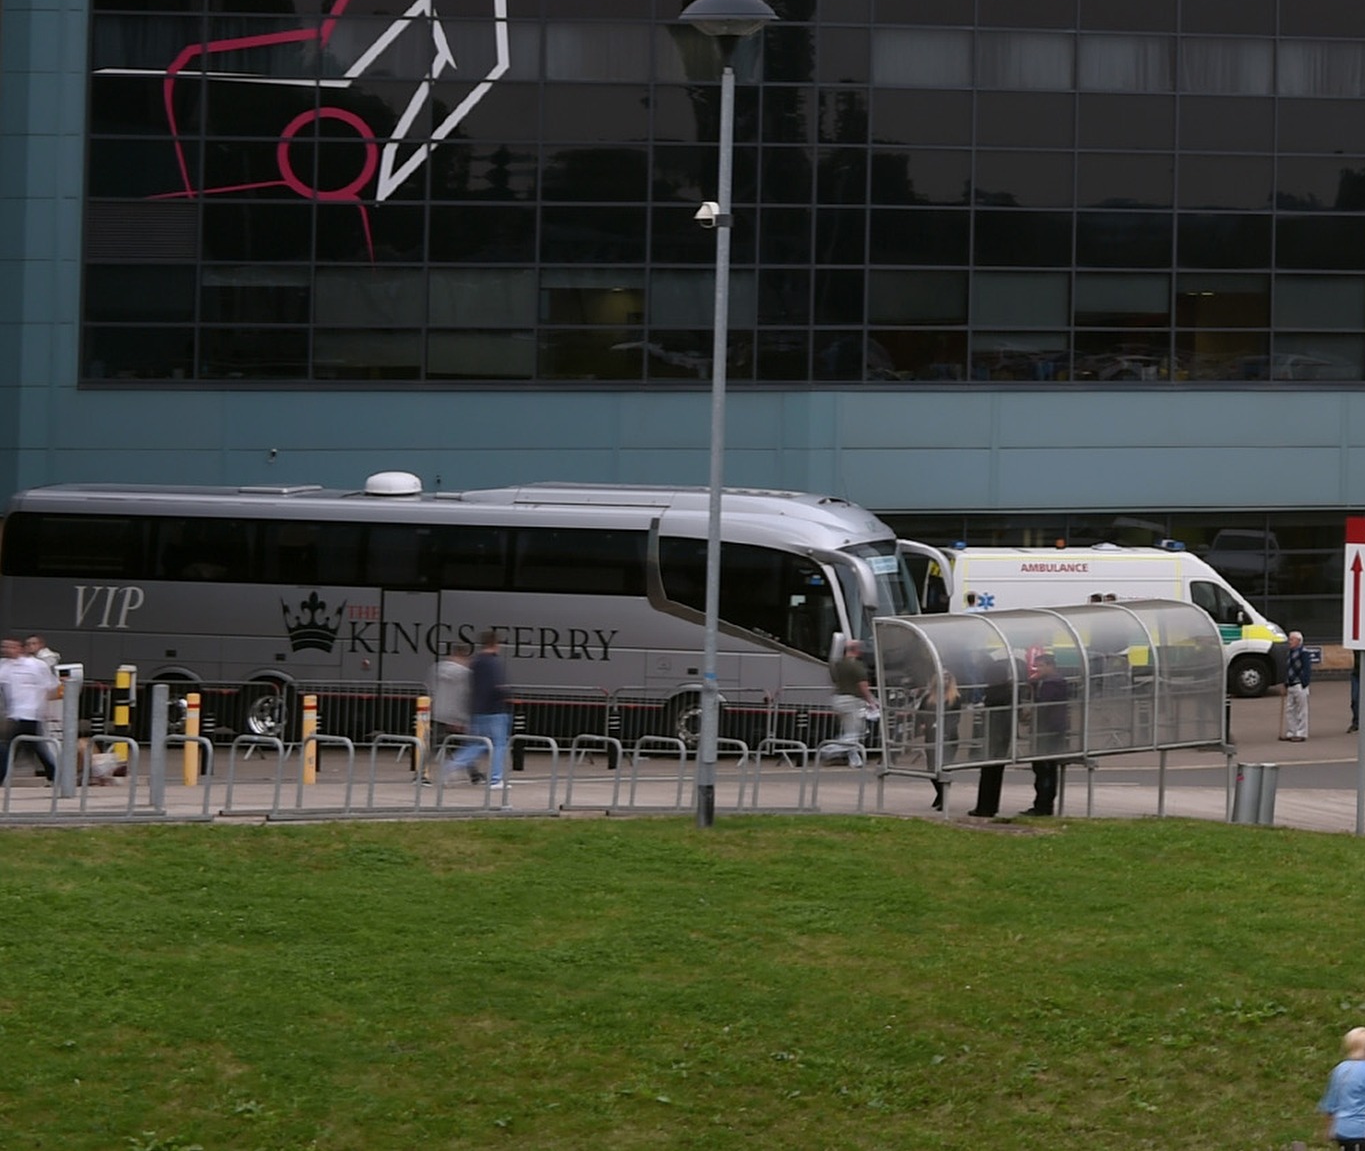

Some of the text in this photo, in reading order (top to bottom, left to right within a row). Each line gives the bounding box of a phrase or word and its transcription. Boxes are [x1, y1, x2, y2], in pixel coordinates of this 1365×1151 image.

[1020, 562, 1089, 573] AMBULANCE
[74, 585, 145, 629] VIP
[348, 605, 381, 620] THE
[349, 621, 475, 657] KINGS
